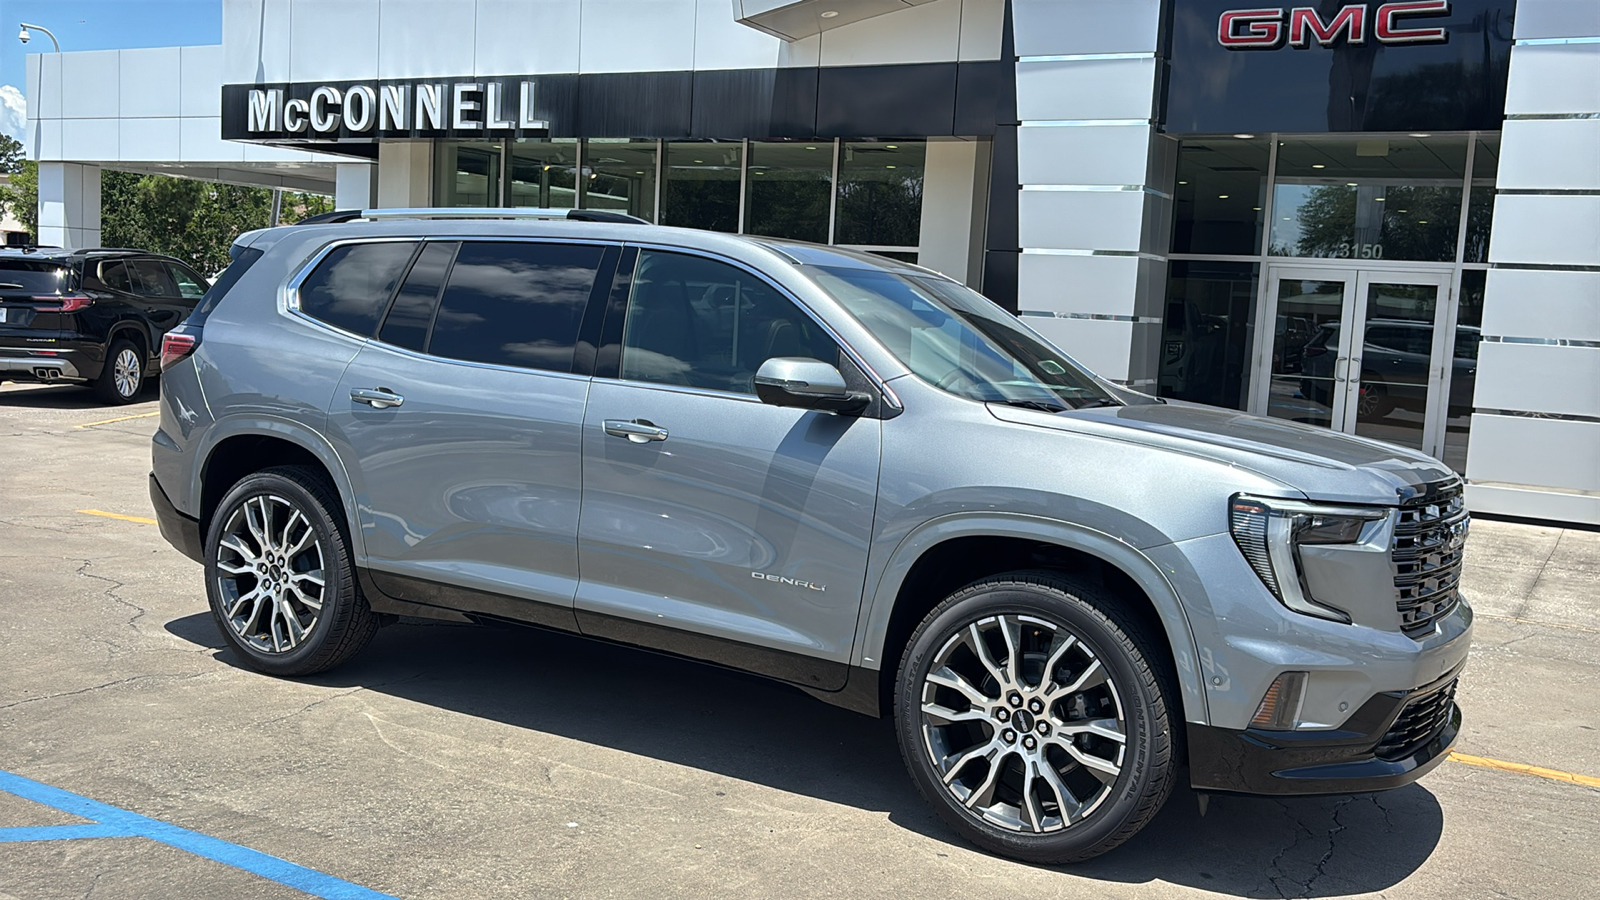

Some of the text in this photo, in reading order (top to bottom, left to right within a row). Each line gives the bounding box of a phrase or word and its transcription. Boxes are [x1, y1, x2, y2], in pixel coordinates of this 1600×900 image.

[1218, 0, 1449, 47] GMC
[248, 81, 549, 132] McCONNELL
[1339, 242, 1383, 259] 3150
[751, 571, 827, 592] DENALI
[1125, 682, 1146, 801] CONTINENTAL
